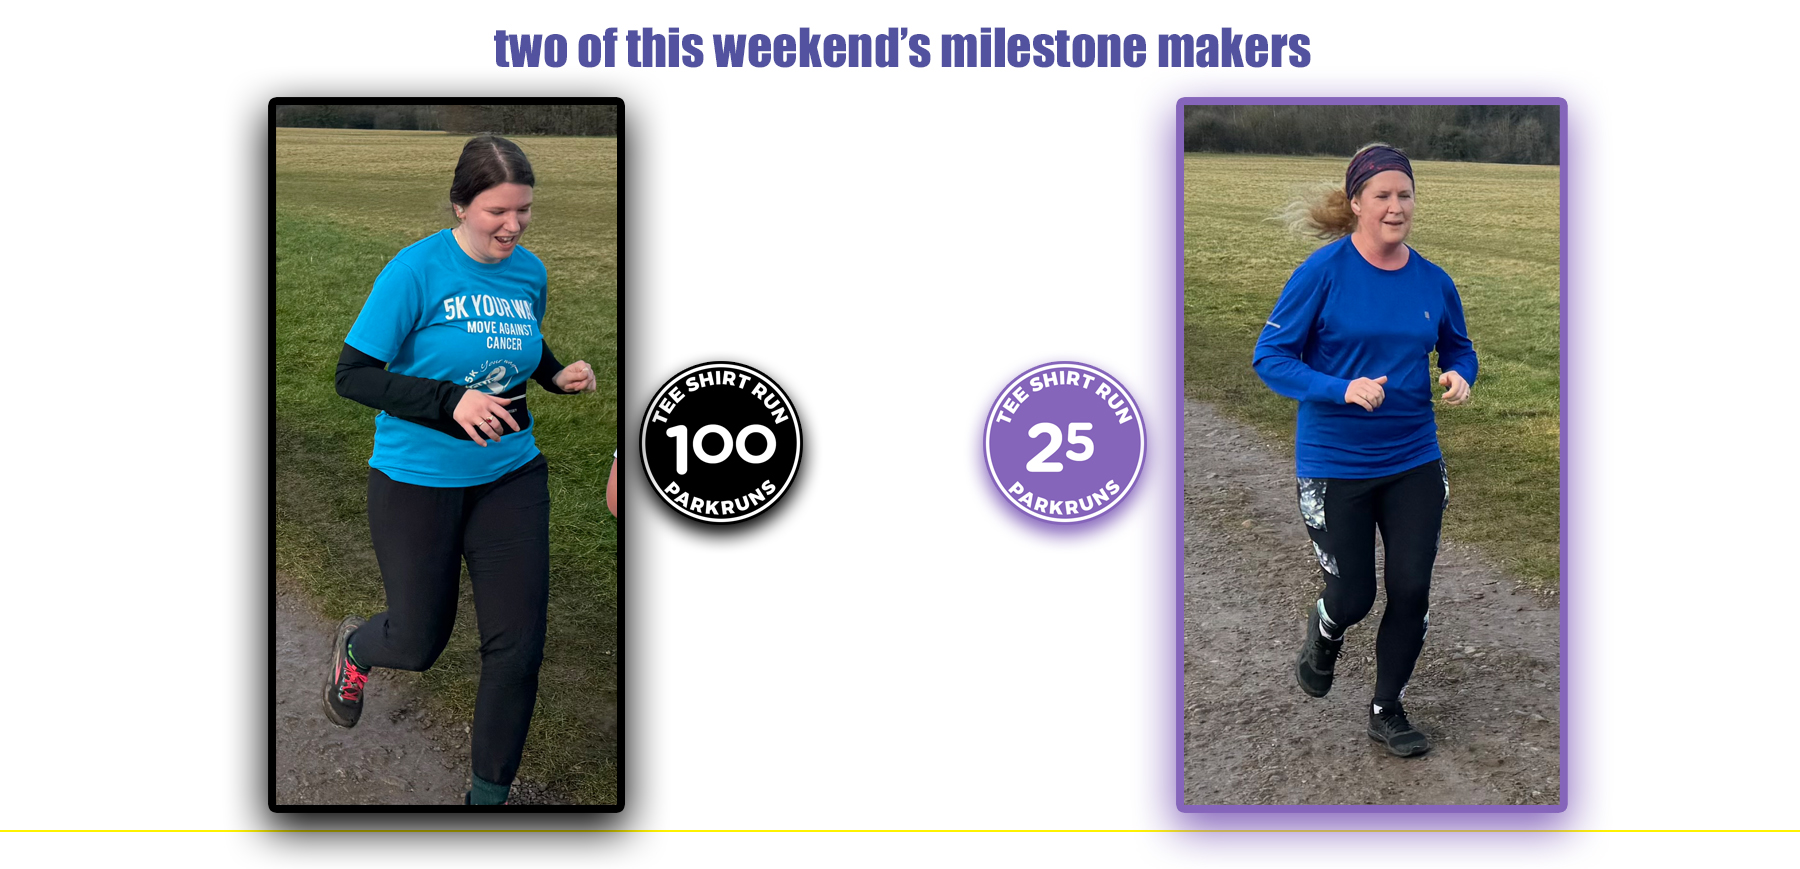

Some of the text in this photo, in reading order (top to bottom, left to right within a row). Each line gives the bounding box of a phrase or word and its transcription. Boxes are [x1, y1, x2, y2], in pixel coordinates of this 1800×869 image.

[443, 295, 470, 320] 5K
[471, 294, 515, 319] YOUR
[467, 321, 533, 336] MOVE AGAINST
[486, 336, 522, 351] CANCER
[464, 369, 479, 383] 5K
